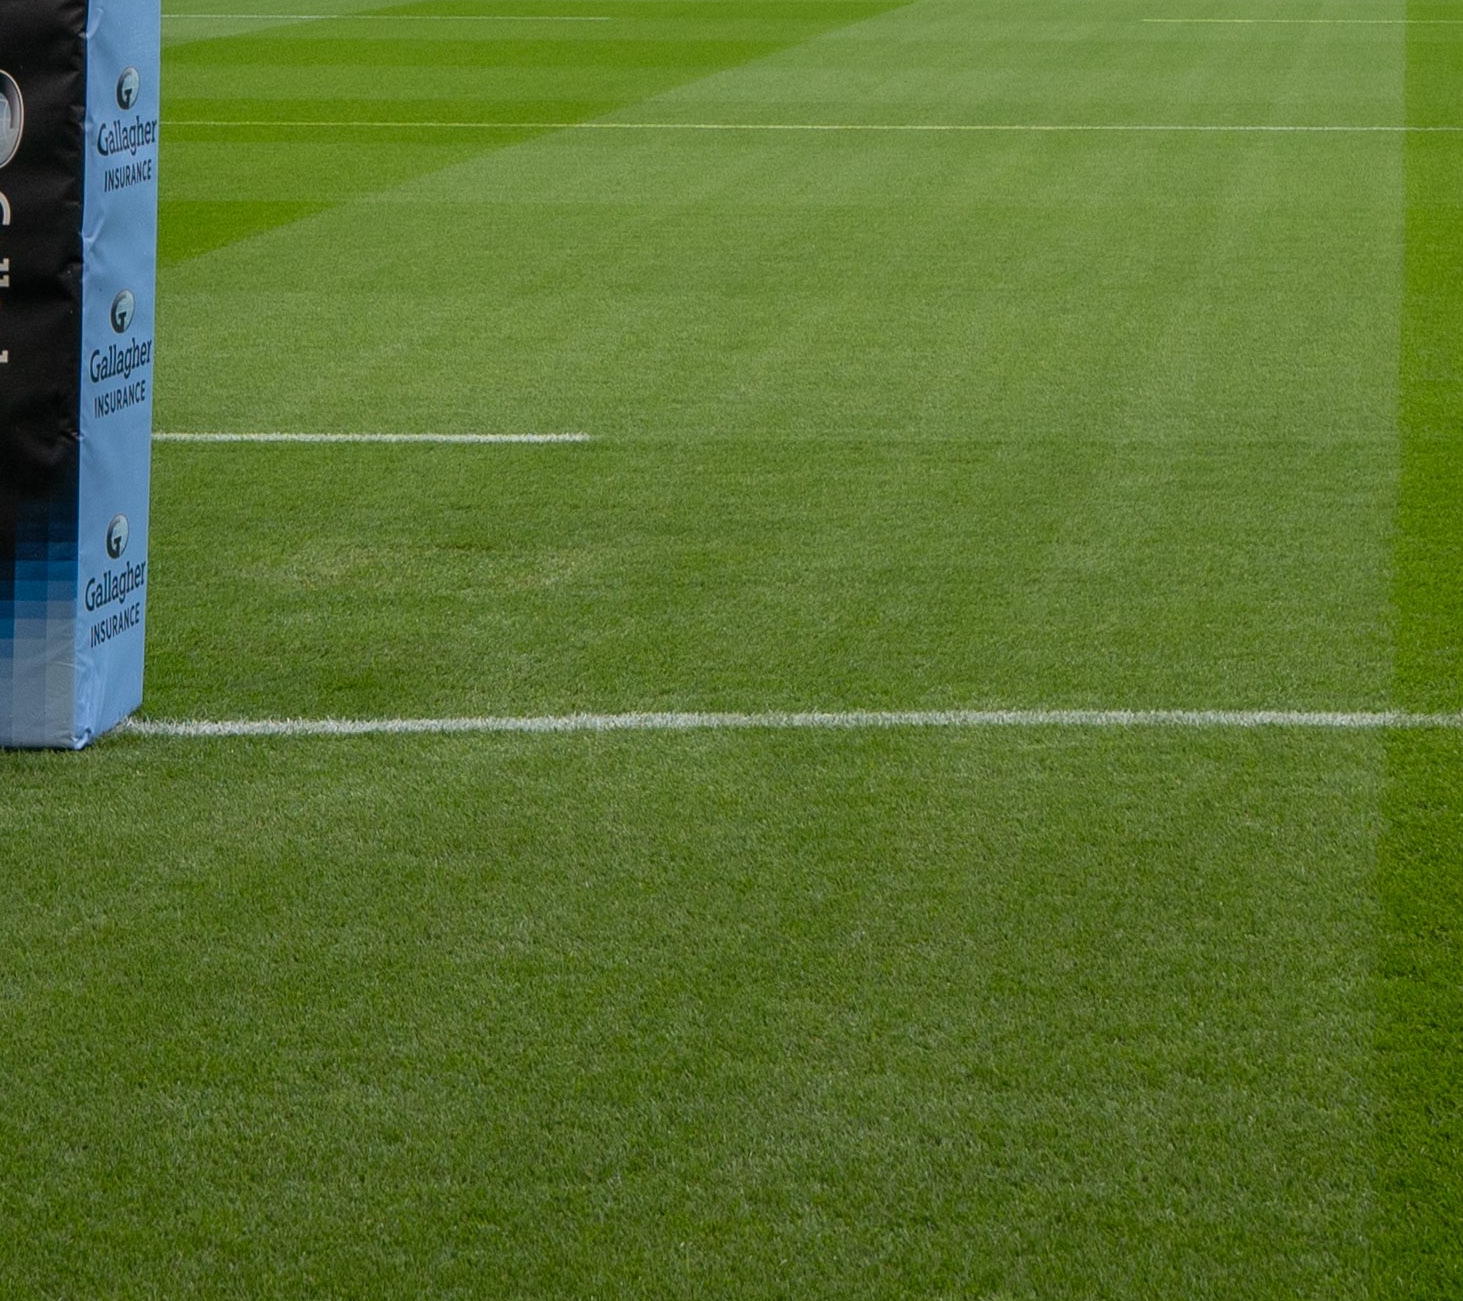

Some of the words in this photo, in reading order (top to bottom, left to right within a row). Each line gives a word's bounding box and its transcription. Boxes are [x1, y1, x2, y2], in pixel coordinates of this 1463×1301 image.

[97, 118, 157, 157] Gallagher
[104, 159, 152, 192] INSURANCE
[90, 336, 151, 385] Gallagher
[94, 379, 146, 419] INSURANCE
[85, 559, 146, 612] Gallagher
[90, 602, 140, 648] INSURANCE
